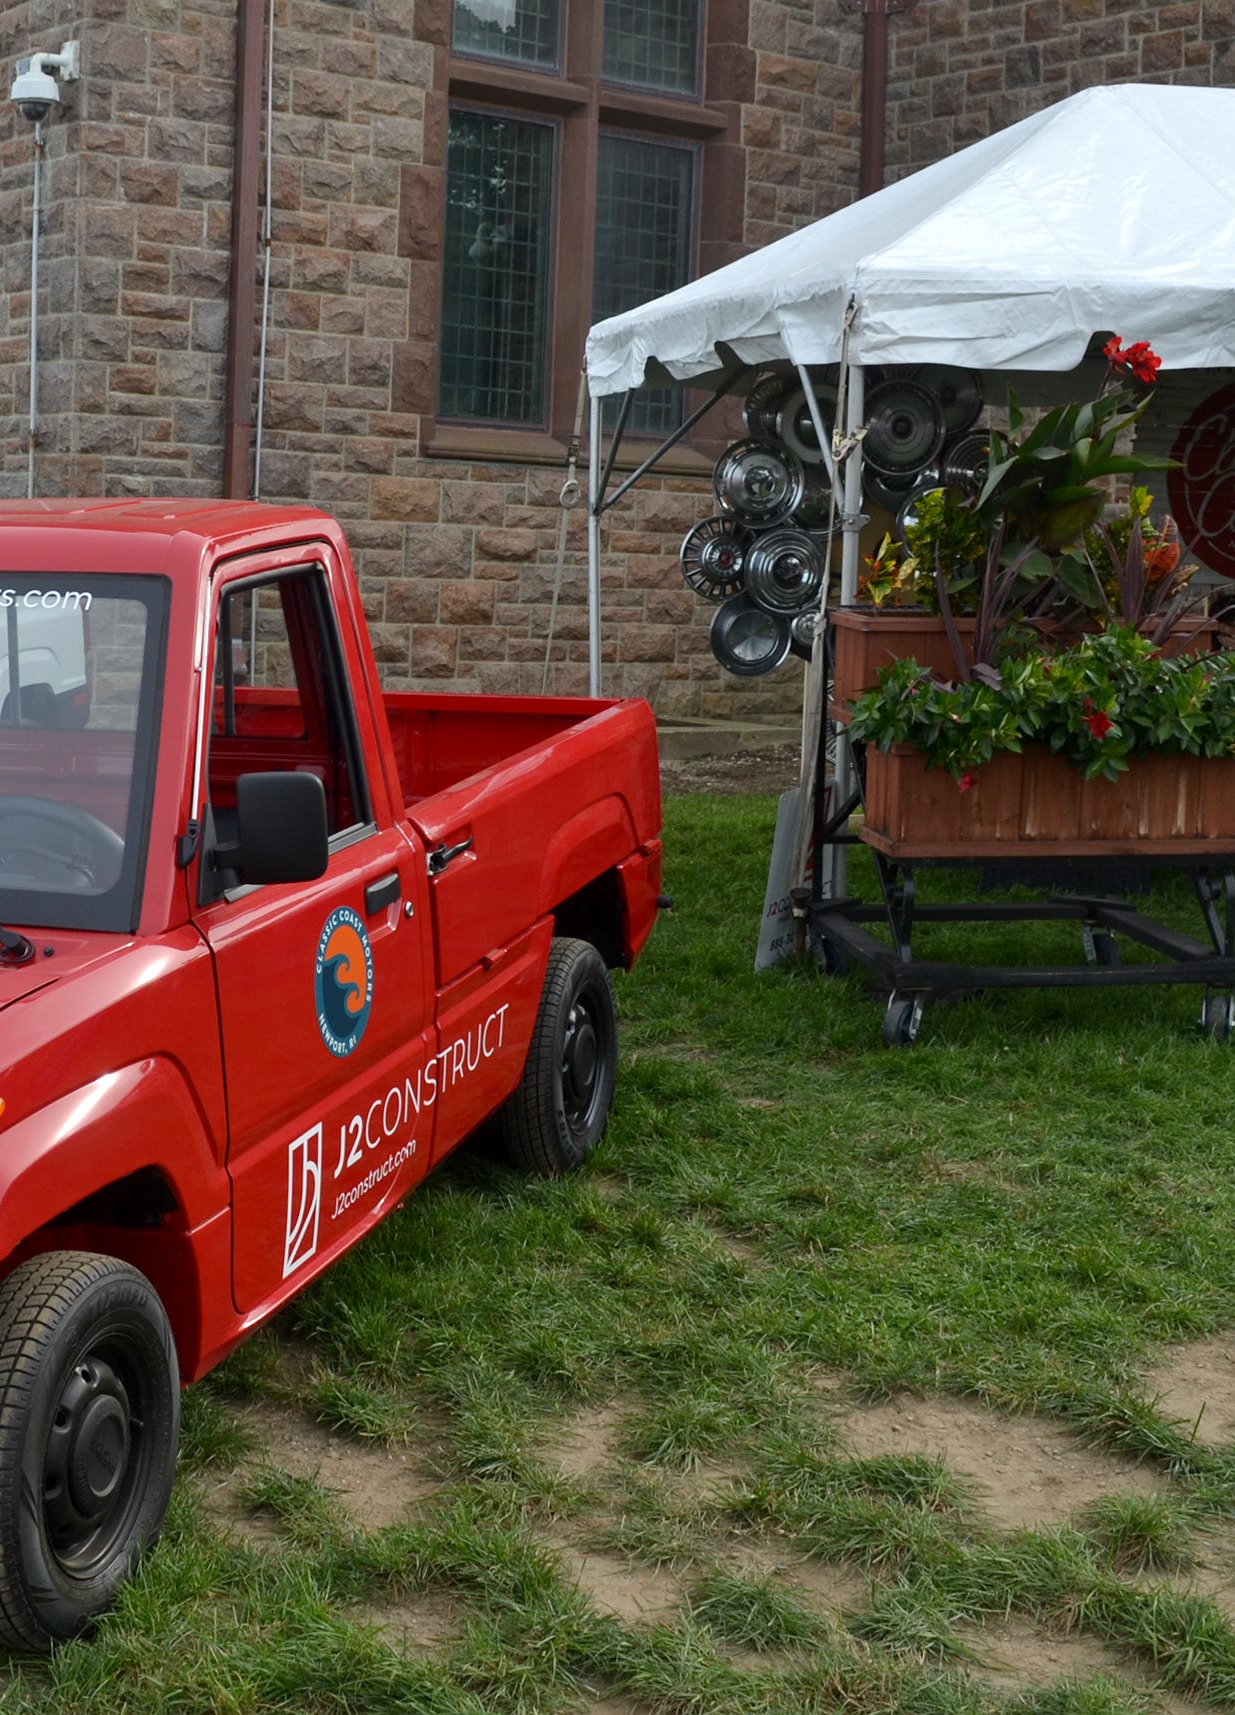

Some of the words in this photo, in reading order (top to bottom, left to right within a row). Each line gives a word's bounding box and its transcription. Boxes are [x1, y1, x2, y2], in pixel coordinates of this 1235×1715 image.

[316, 914, 338, 974] CLASSIC
[339, 910, 363, 932] COAST
[361, 934, 373, 1002] MOTORS
[319, 1013, 348, 1055] NEWPORT,
[349, 1034, 357, 1049] RI
[332, 1003, 509, 1180] J2CONSTRUCT
[331, 1137, 416, 1220] J2construct.com
